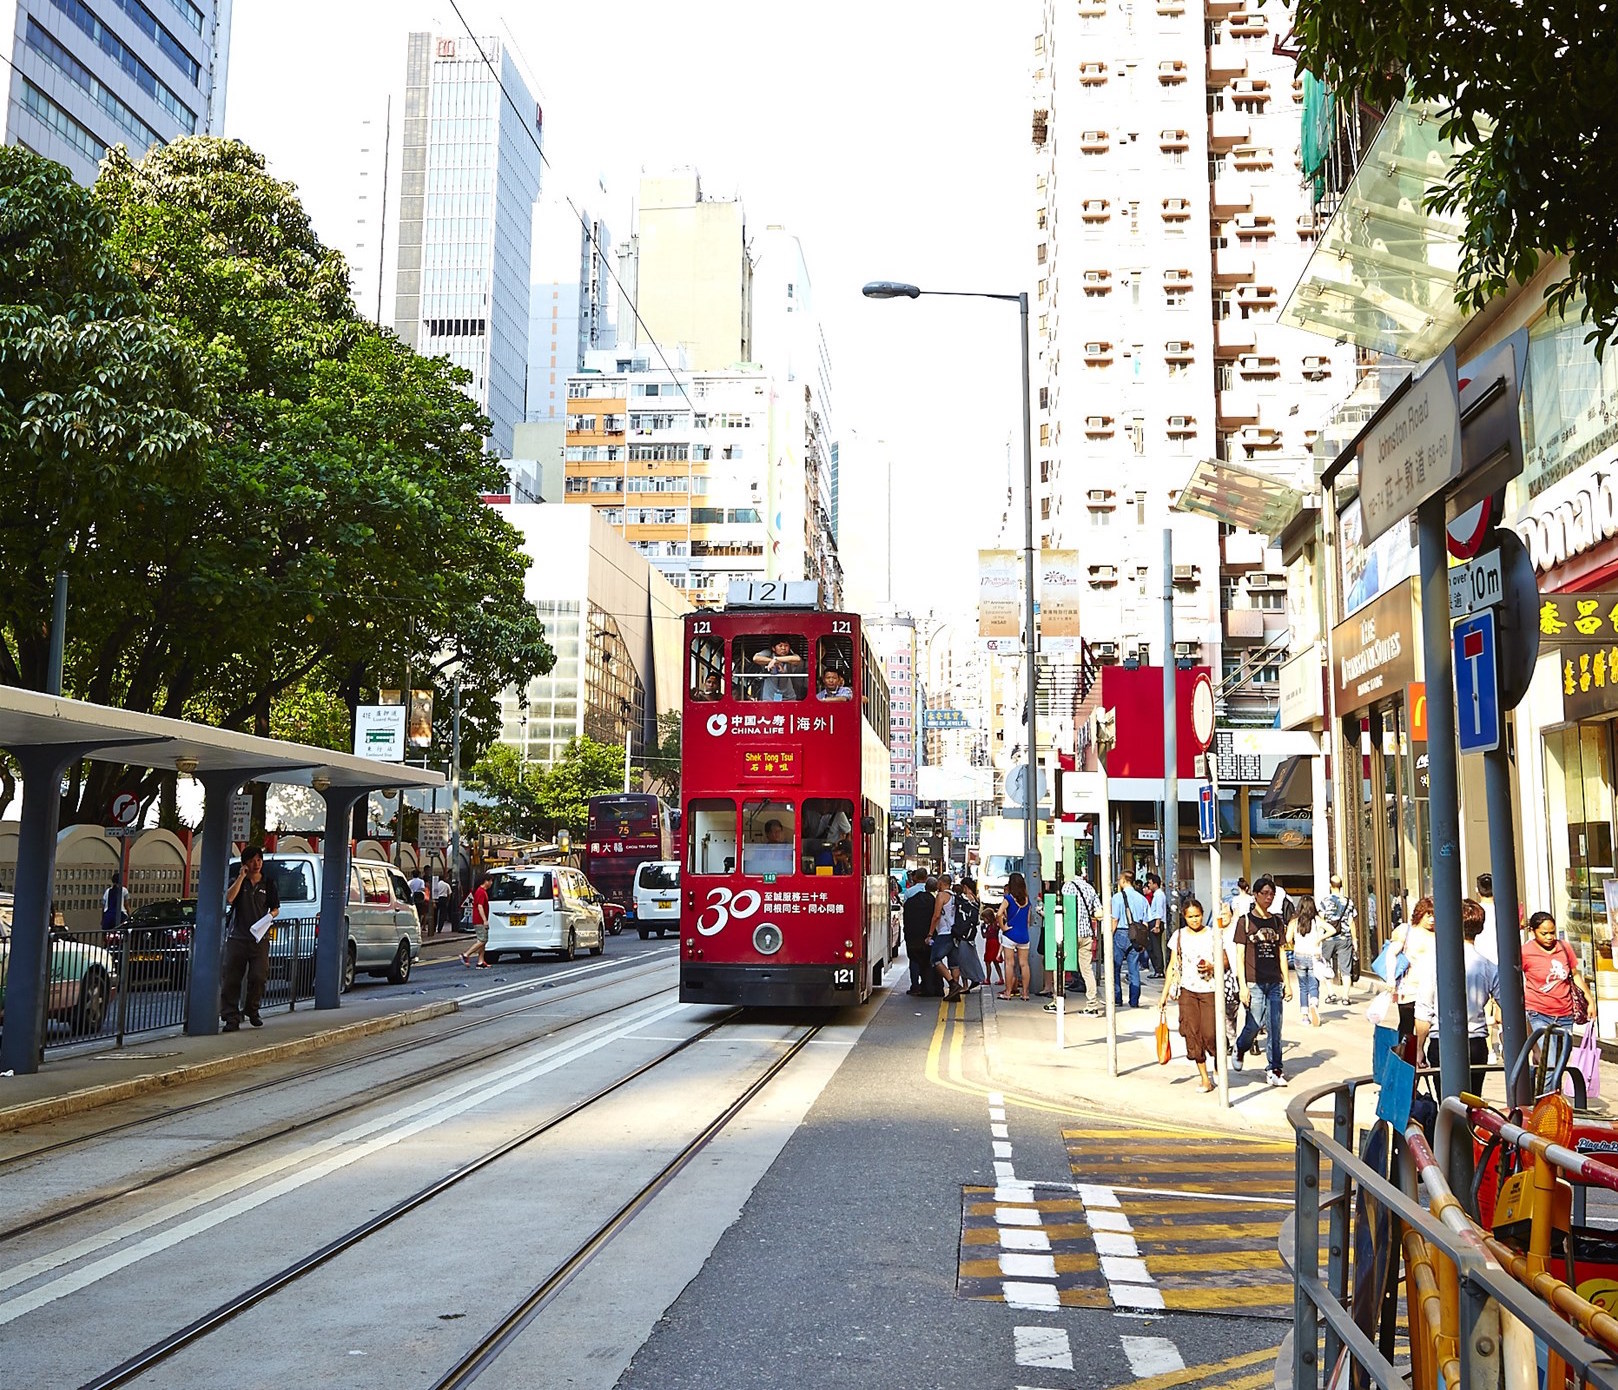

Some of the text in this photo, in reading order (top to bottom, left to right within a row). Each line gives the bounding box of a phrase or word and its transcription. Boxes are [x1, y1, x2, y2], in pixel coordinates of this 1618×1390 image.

[1378, 392, 1429, 464] Johnston Road
[1470, 566, 1499, 602] 10m
[748, 582, 787, 601] 121
[693, 621, 712, 634] 121
[832, 621, 852, 634] 121
[796, 717, 827, 731] 海外
[745, 752, 794, 763] Shek Tong Tsui
[618, 826, 630, 835] 75
[590, 842, 624, 854] 周大福
[764, 891, 828, 902] 至誠服務三十年
[697, 887, 761, 936] 30
[834, 969, 854, 983] 121
